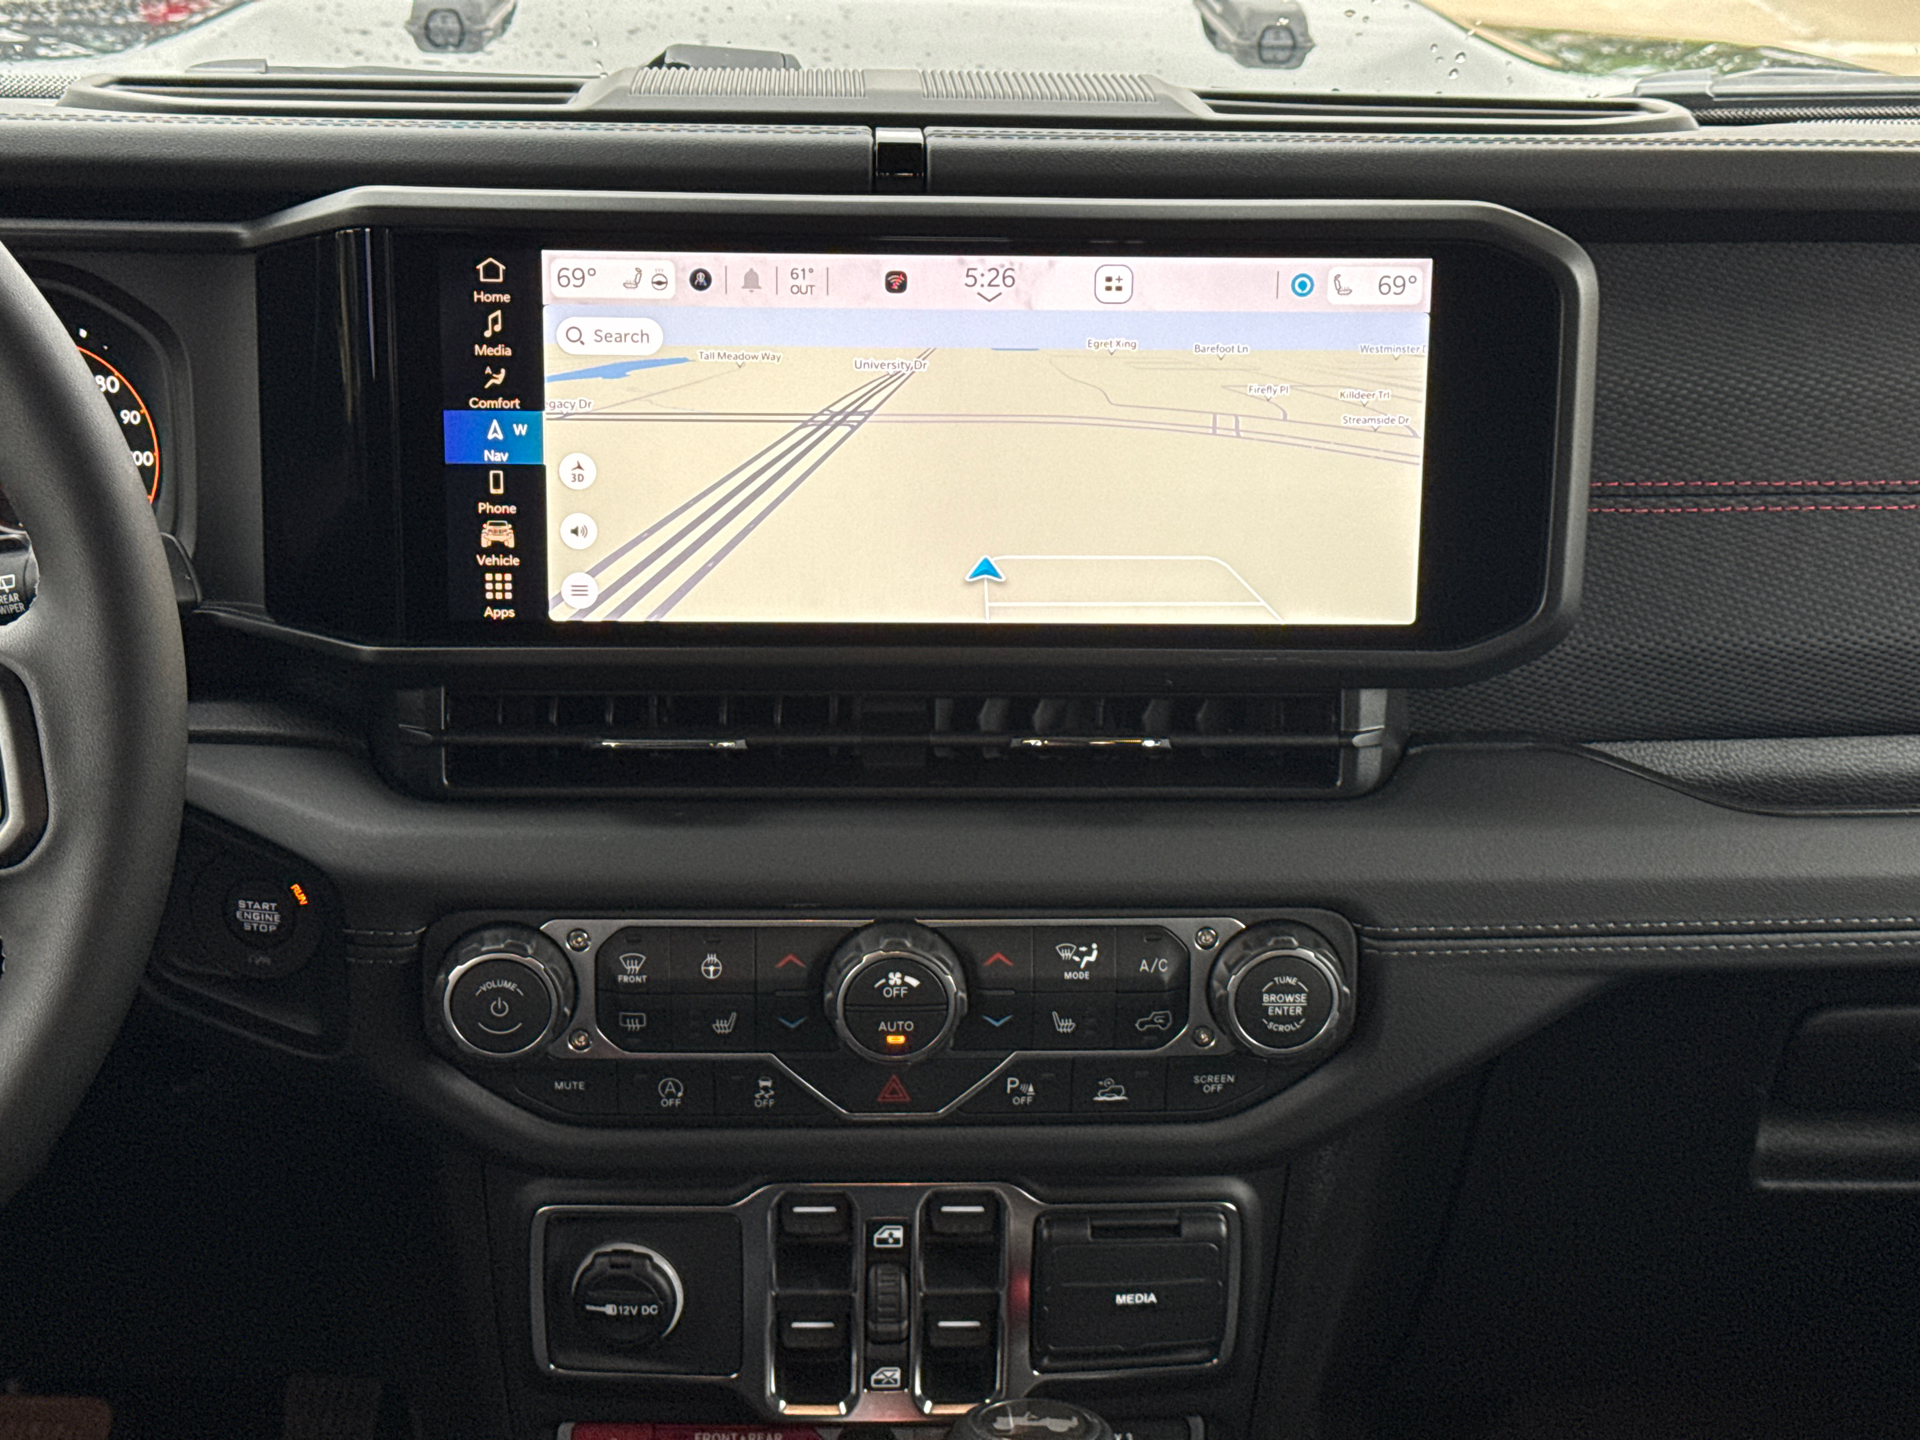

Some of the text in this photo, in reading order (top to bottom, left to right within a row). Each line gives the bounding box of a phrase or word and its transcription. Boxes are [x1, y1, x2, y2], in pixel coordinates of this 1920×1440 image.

[557, 267, 597, 288] 69°
[790, 267, 814, 280] 61°
[964, 267, 1016, 288] 5:26
[790, 284, 815, 295] OUT
[1378, 275, 1418, 296] 69°
[473, 291, 511, 303] Home
[593, 329, 650, 344] Search
[474, 344, 512, 356] Media
[1087, 339, 1137, 350] Egret Xing
[1194, 344, 1249, 354] Barefoot Ln
[1360, 344, 1420, 354] Westminster
[699, 351, 782, 363] Tall Meadow Way
[854, 359, 927, 372] University Dr
[95, 374, 120, 394] 80
[1248, 385, 1278, 396] Firefly
[1340, 391, 1376, 399] Killdeer
[468, 397, 521, 409] Comfort
[578, 399, 592, 409] Dr
[120, 409, 141, 425] 90
[1342, 415, 1410, 425] Streamside Dr
[512, 423, 528, 436] W
[132, 450, 154, 467] 00
[483, 450, 509, 462] Nav
[571, 473, 584, 483] 3D
[478, 502, 517, 515] Phone
[476, 554, 521, 567] Vehicle
[483, 606, 516, 620] Apps
[290, 883, 309, 906] RUN
[238, 900, 277, 911] START
[236, 910, 280, 922] ENGINE
[243, 922, 277, 933] STOP
[1139, 957, 1168, 973] A/C
[617, 975, 647, 984] FRONT
[1064, 971, 1090, 980] MODE
[1273, 976, 1298, 986] TUNE
[479, 979, 518, 992] VOLUME
[883, 986, 908, 998] OFF
[1262, 993, 1308, 1003] BROWSE
[1268, 1006, 1303, 1016] ENTER
[878, 1021, 914, 1032] AUTO
[1267, 1021, 1301, 1032] SCROLL
[1193, 1074, 1235, 1084] SCREEN
[554, 1081, 585, 1091] MUTE
[1203, 1083, 1223, 1093] OFF
[660, 1098, 681, 1107] OFF
[754, 1098, 775, 1108] OFF
[1012, 1096, 1033, 1106] OFF
[1115, 1291, 1158, 1306] MEDIA
[618, 1304, 659, 1316] 12V DC
